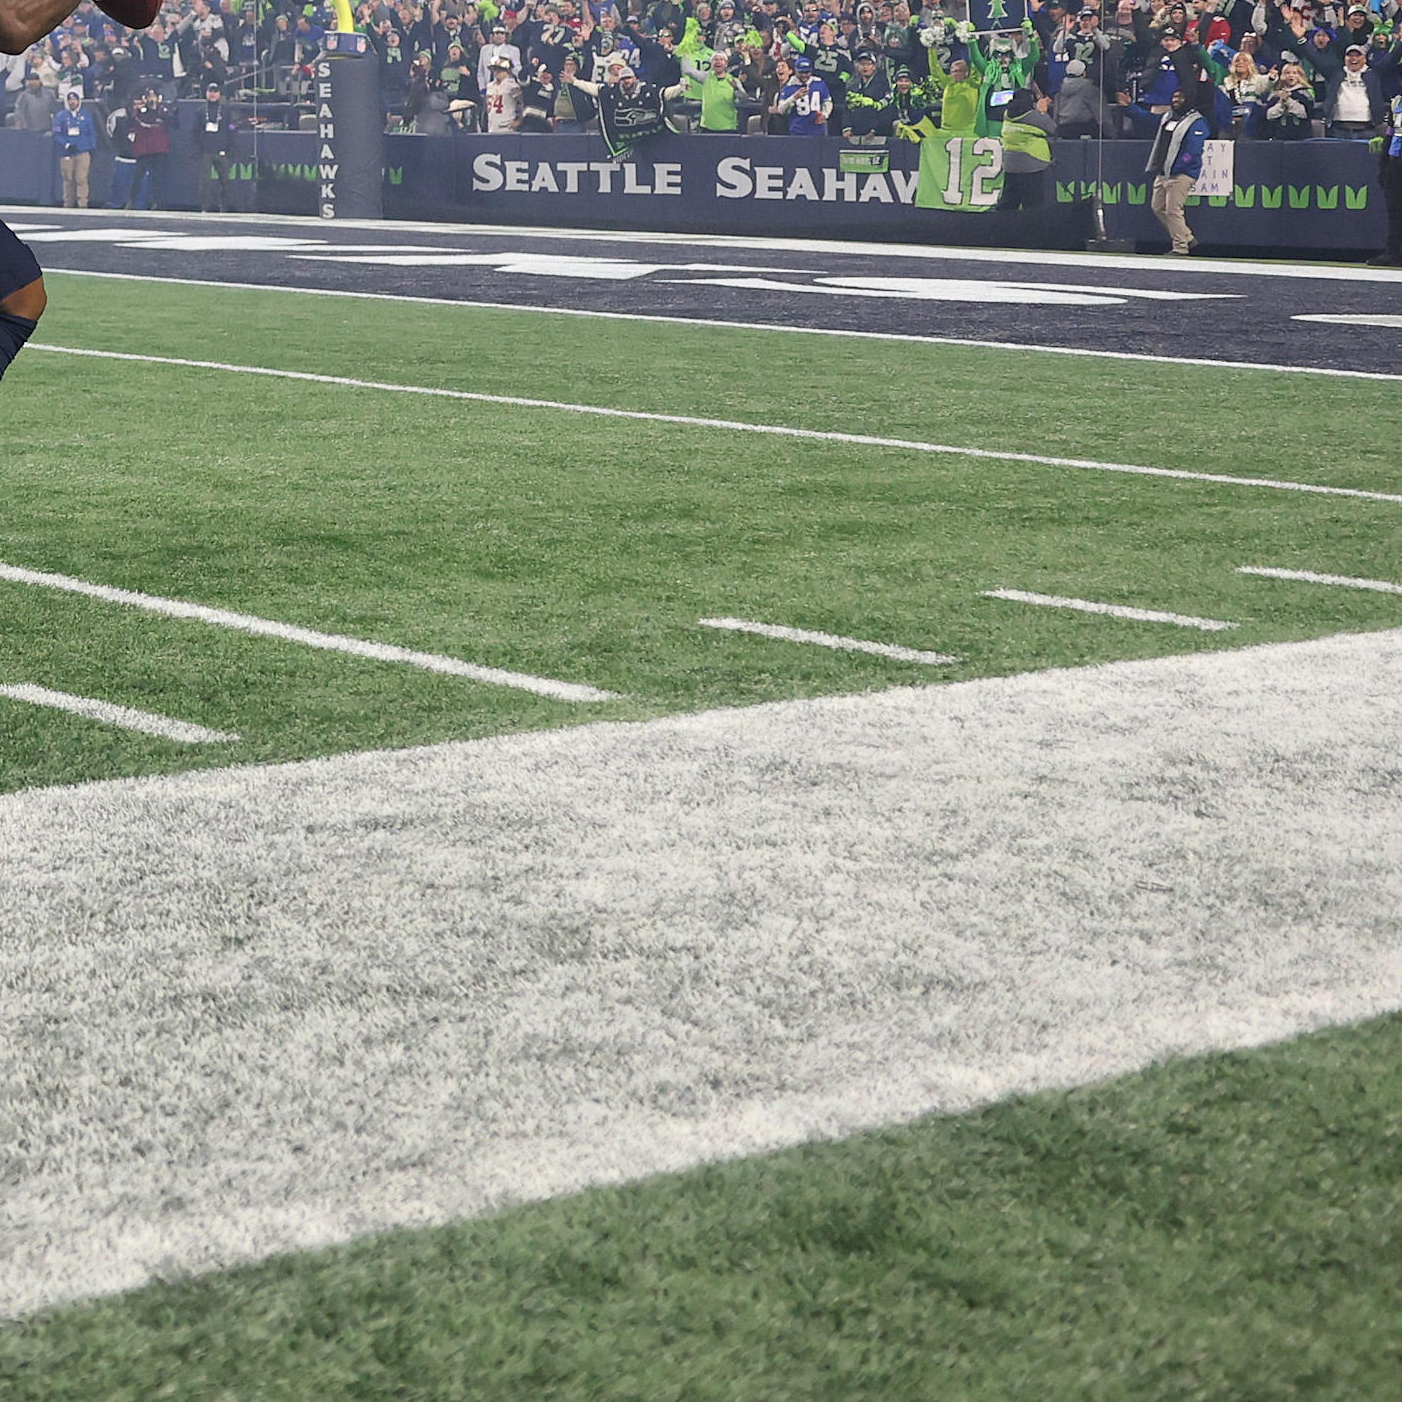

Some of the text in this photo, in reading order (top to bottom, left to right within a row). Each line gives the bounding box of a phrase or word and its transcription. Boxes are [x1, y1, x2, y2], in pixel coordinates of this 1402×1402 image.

[317, 61, 339, 219] SEAHAWKS
[472, 153, 682, 195] SEATTLE
[941, 137, 1003, 206] 12
